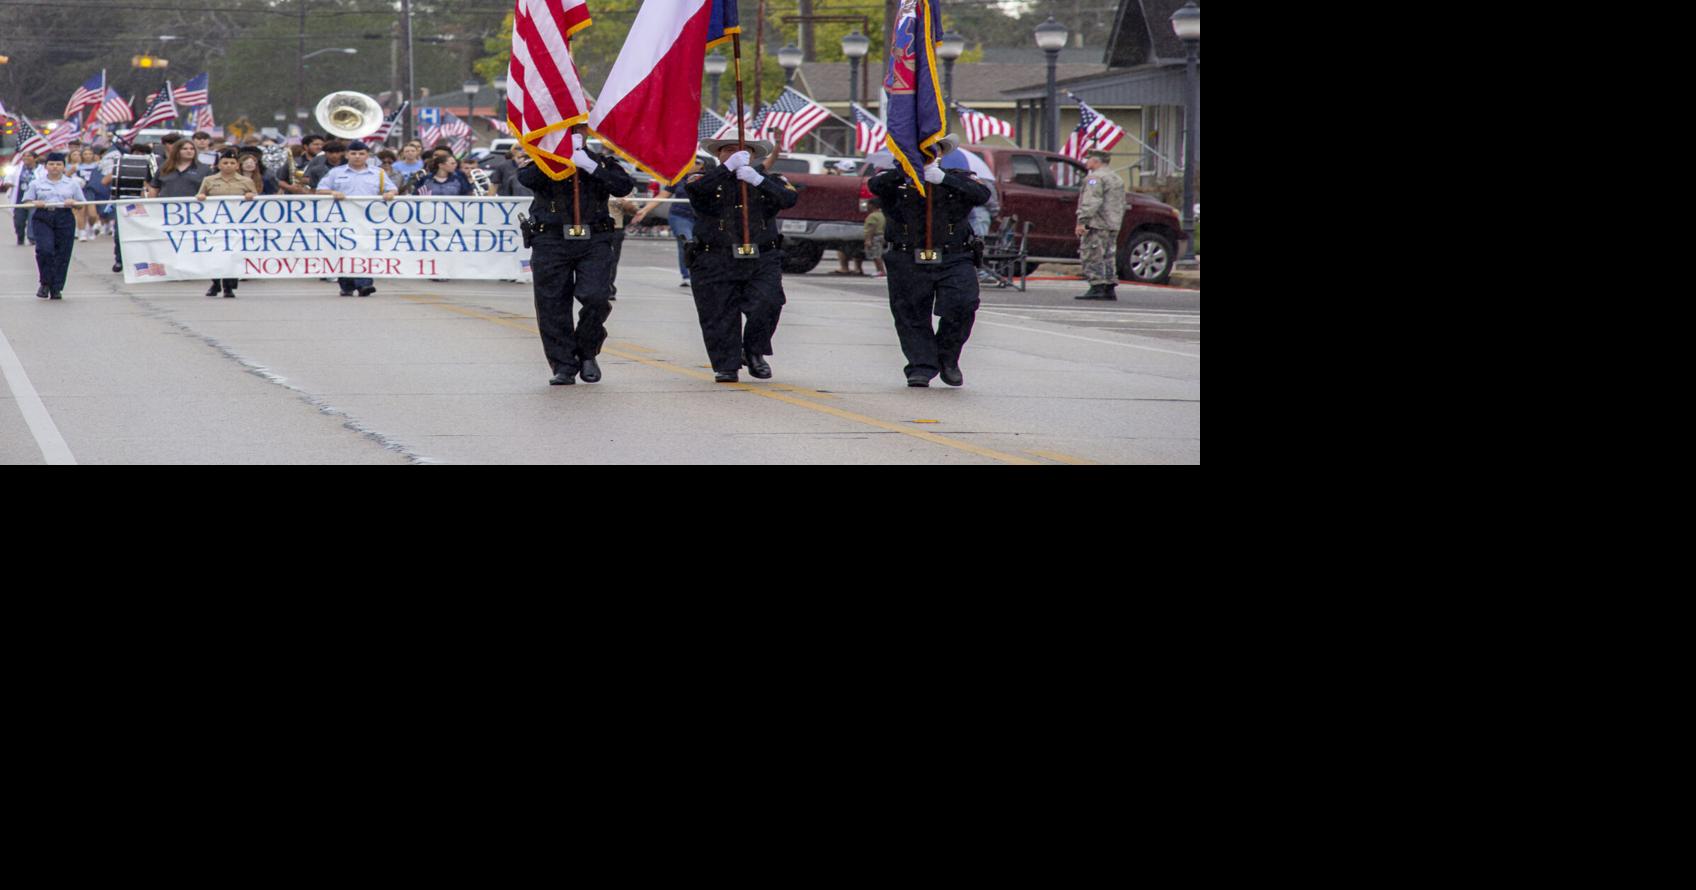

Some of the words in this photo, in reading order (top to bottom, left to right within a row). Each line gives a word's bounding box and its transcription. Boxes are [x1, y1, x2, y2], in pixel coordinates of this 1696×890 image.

[421, 108, 437, 124] H
[162, 200, 347, 226] BRAZORIA
[365, 200, 519, 225] COUNTY
[165, 227, 357, 253] VETERANS
[374, 229, 519, 252] PARADE
[244, 257, 402, 275] NOVEMBER
[418, 259, 438, 275] 11
